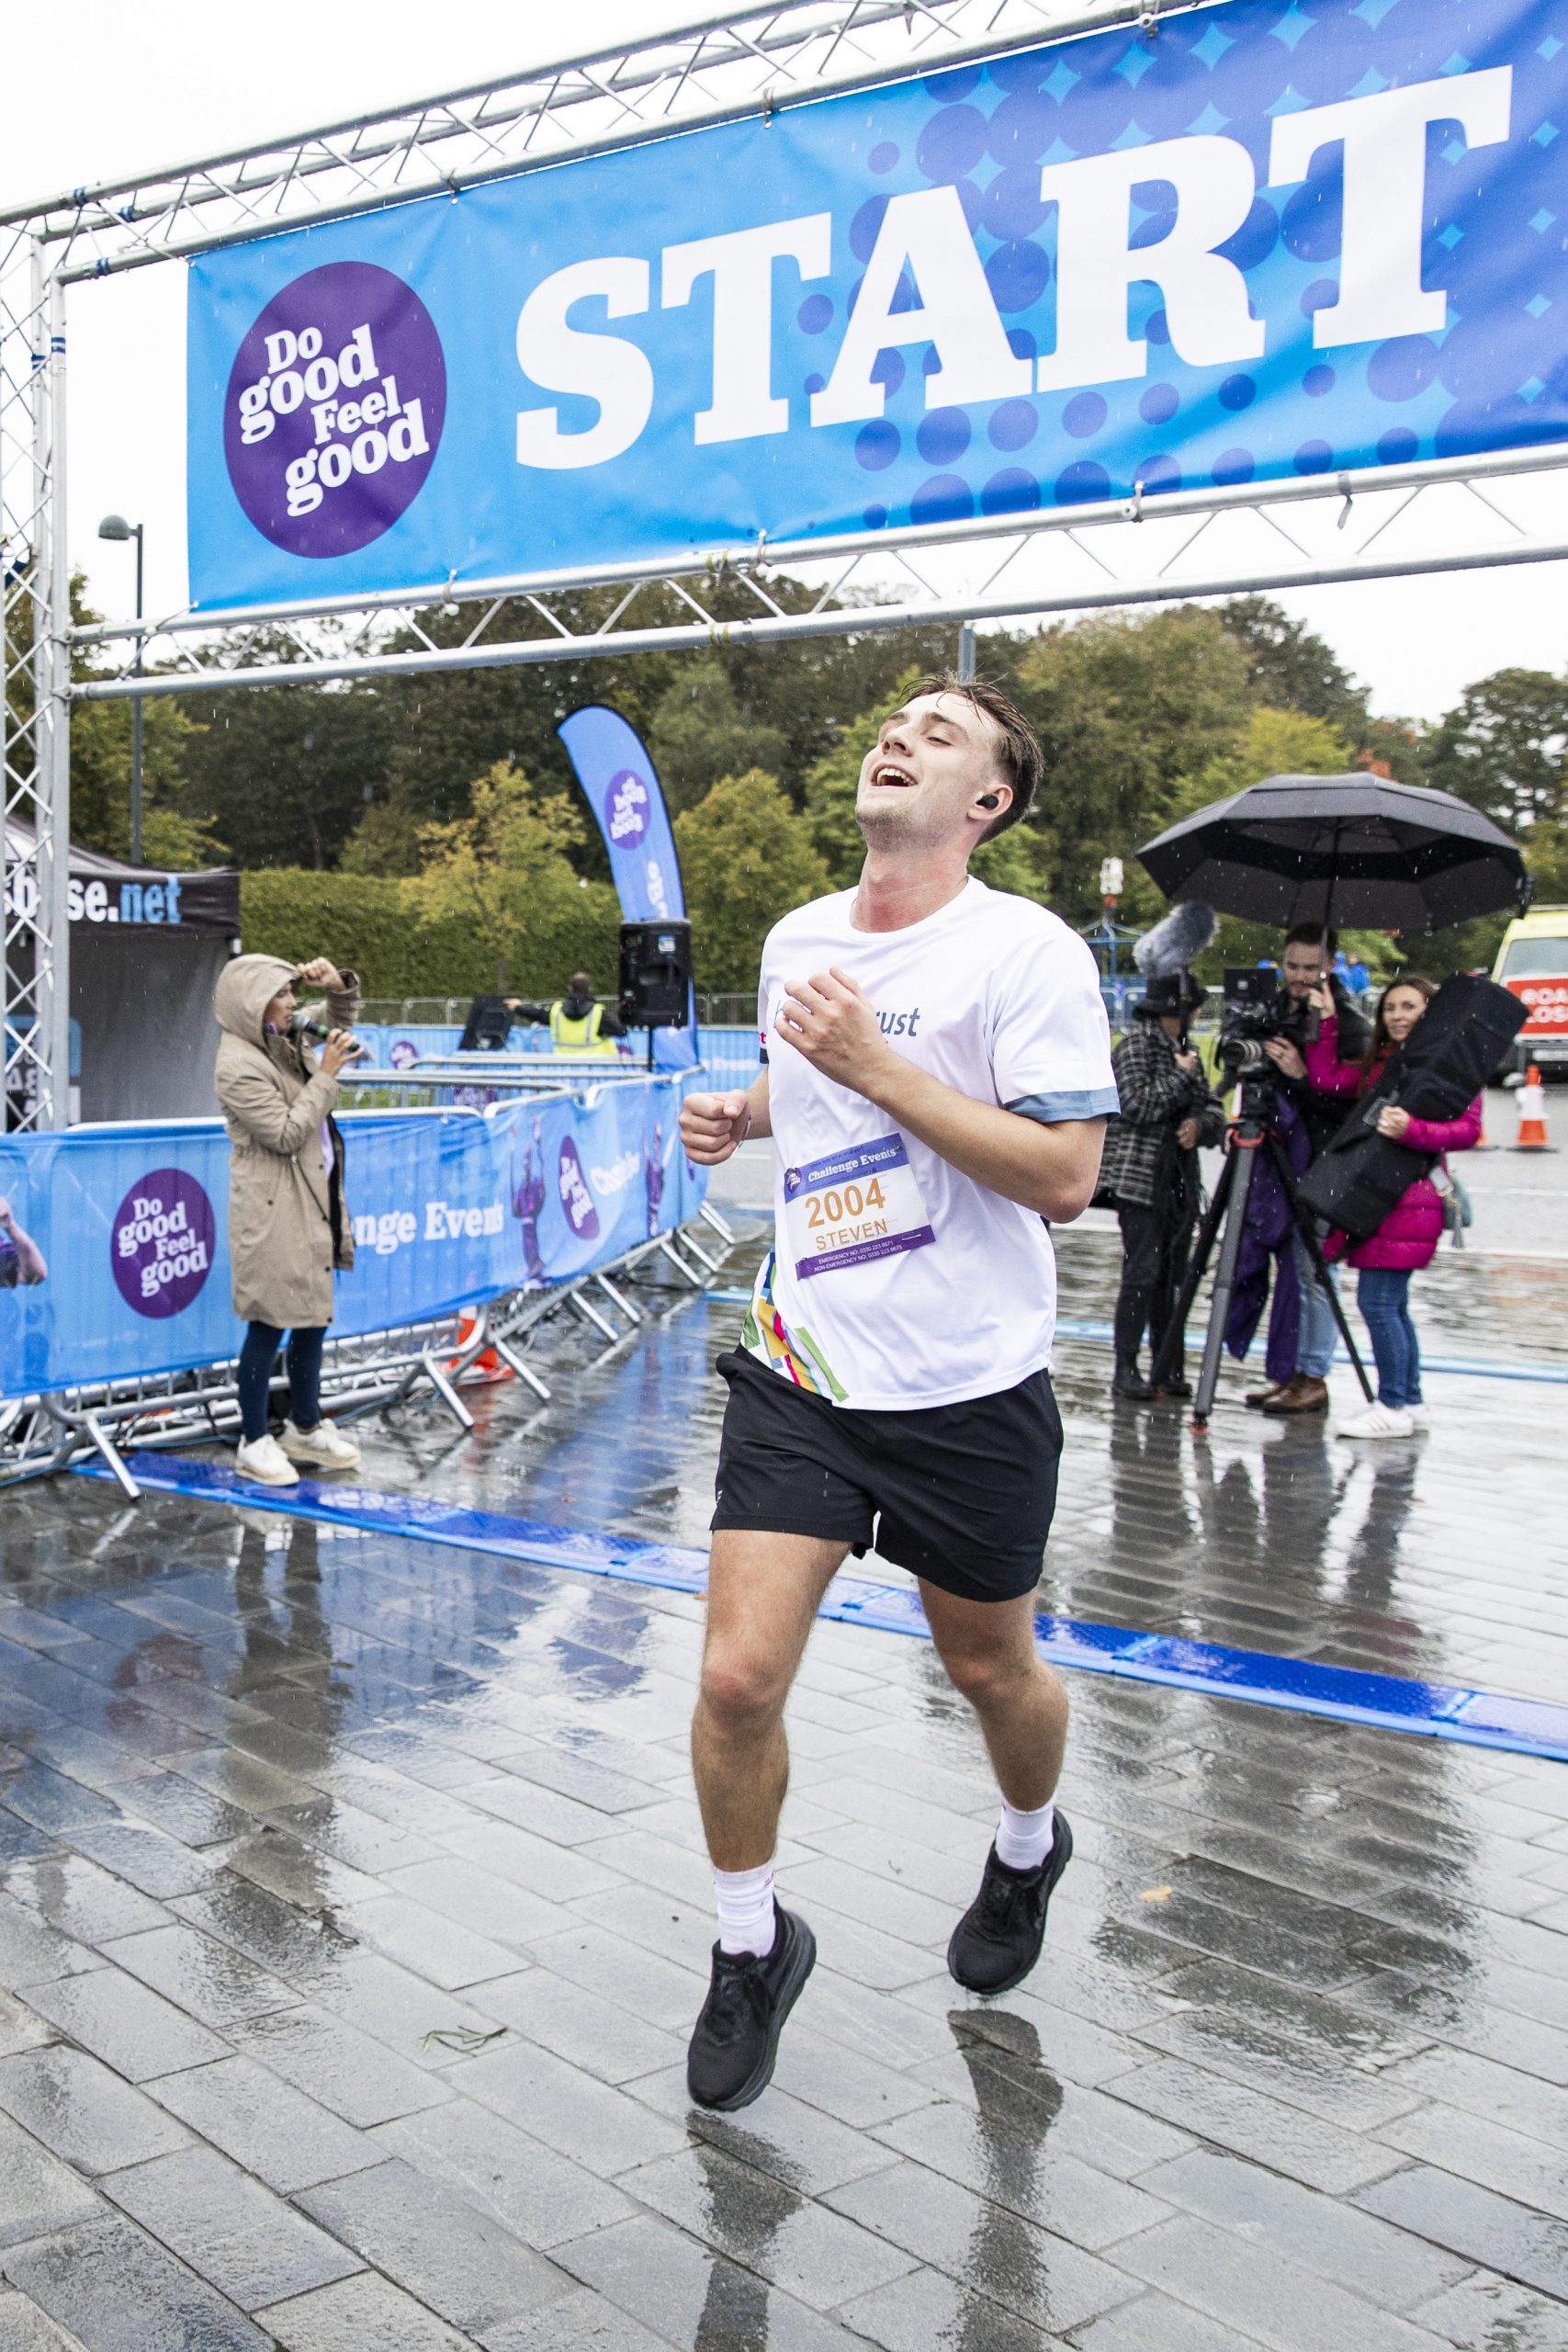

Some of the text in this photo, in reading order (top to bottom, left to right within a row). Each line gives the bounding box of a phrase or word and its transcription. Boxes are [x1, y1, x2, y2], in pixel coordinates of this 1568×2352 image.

[516, 65, 1513, 469] START
[264, 327, 323, 374] Do
[238, 323, 379, 445] good
[310, 375, 401, 445] Feel
[285, 398, 430, 517] good
[875, 1007, 921, 1037] ust
[807, 1159, 859, 1182] Challenge
[860, 1148, 897, 1166] Events
[132, 1197, 163, 1222] Do
[805, 1178, 886, 1228] 2004
[118, 1201, 187, 1258] good
[154, 1227, 197, 1261] Feel
[351, 1209, 417, 1256] nge
[816, 1218, 888, 1250] STEVEN
[141, 1241, 209, 1298] good
[814, 1256, 857, 1272] NON-EMERGENCY
[868, 1250, 880, 1259] 0330
[818, 1252, 849, 1264] EMERGENCY
[859, 1246, 872, 1254] 0330
